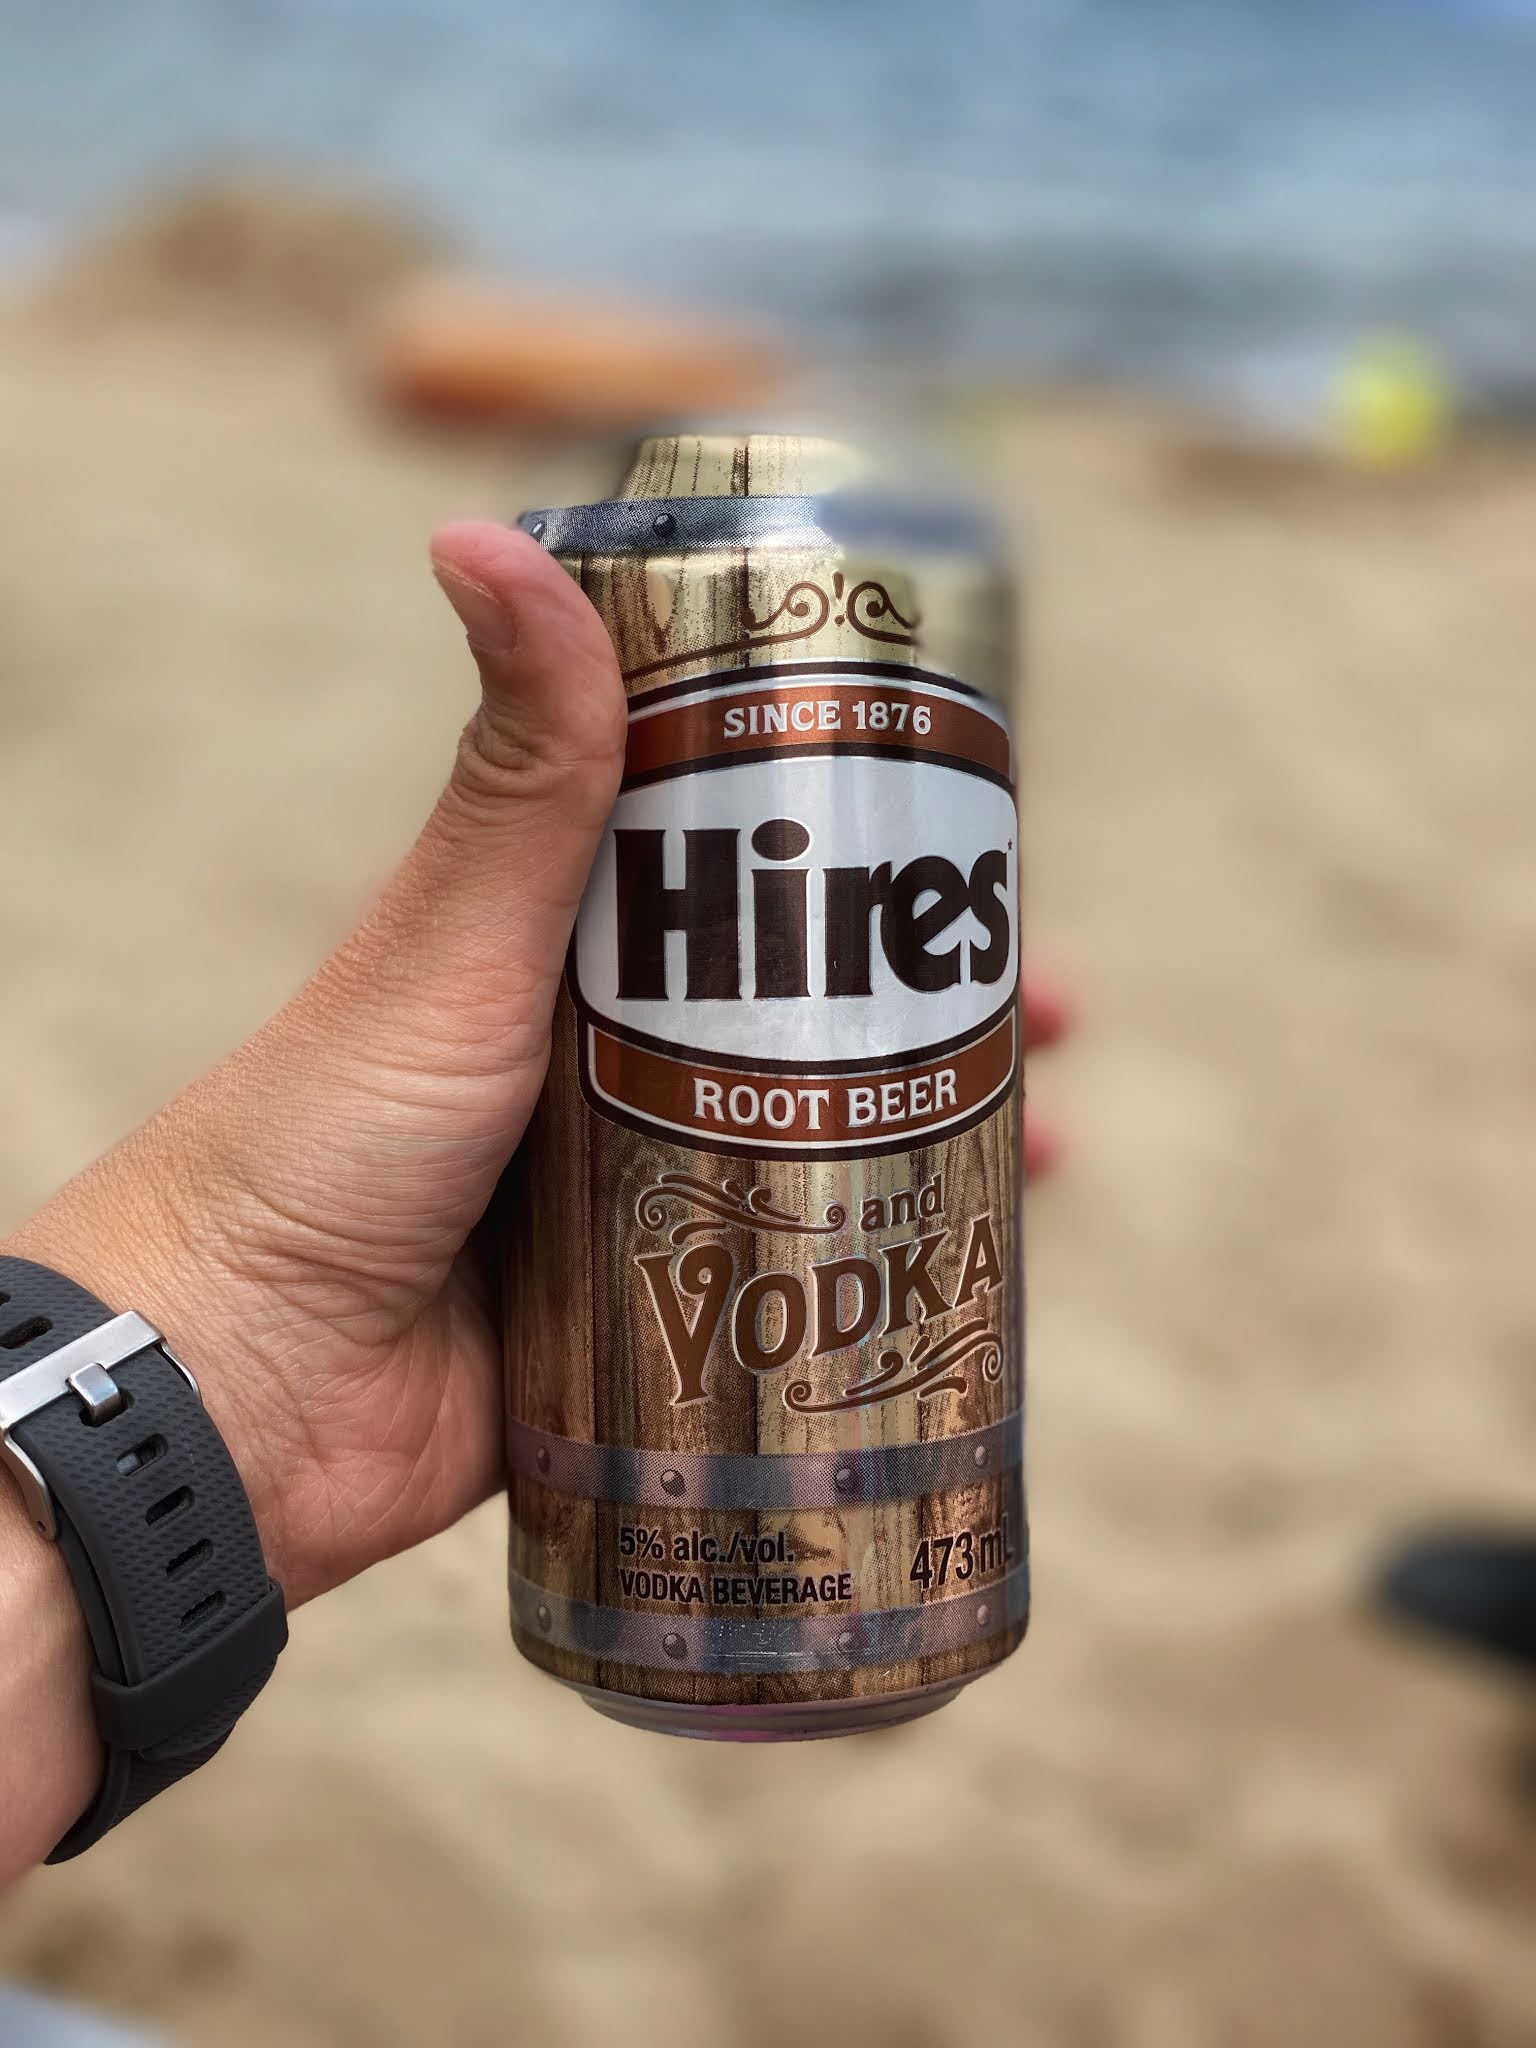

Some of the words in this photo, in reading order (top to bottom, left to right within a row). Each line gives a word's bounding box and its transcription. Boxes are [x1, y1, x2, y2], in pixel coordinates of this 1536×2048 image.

[723, 700, 841, 739] SINCE
[853, 701, 932, 735] 1876
[613, 819, 1008, 1000] Hires
[694, 1078, 829, 1130] ROOT
[847, 1070, 957, 1127] BEER
[858, 1173, 944, 1233] and
[636, 1214, 1003, 1405] VODKA
[620, 1526, 664, 1559] 5%
[673, 1529, 795, 1563] alc./vol.
[910, 1530, 973, 1590] 473
[979, 1513, 1013, 1574] mL
[620, 1570, 704, 1604] VODKA
[713, 1573, 852, 1605] BEVERAGE
